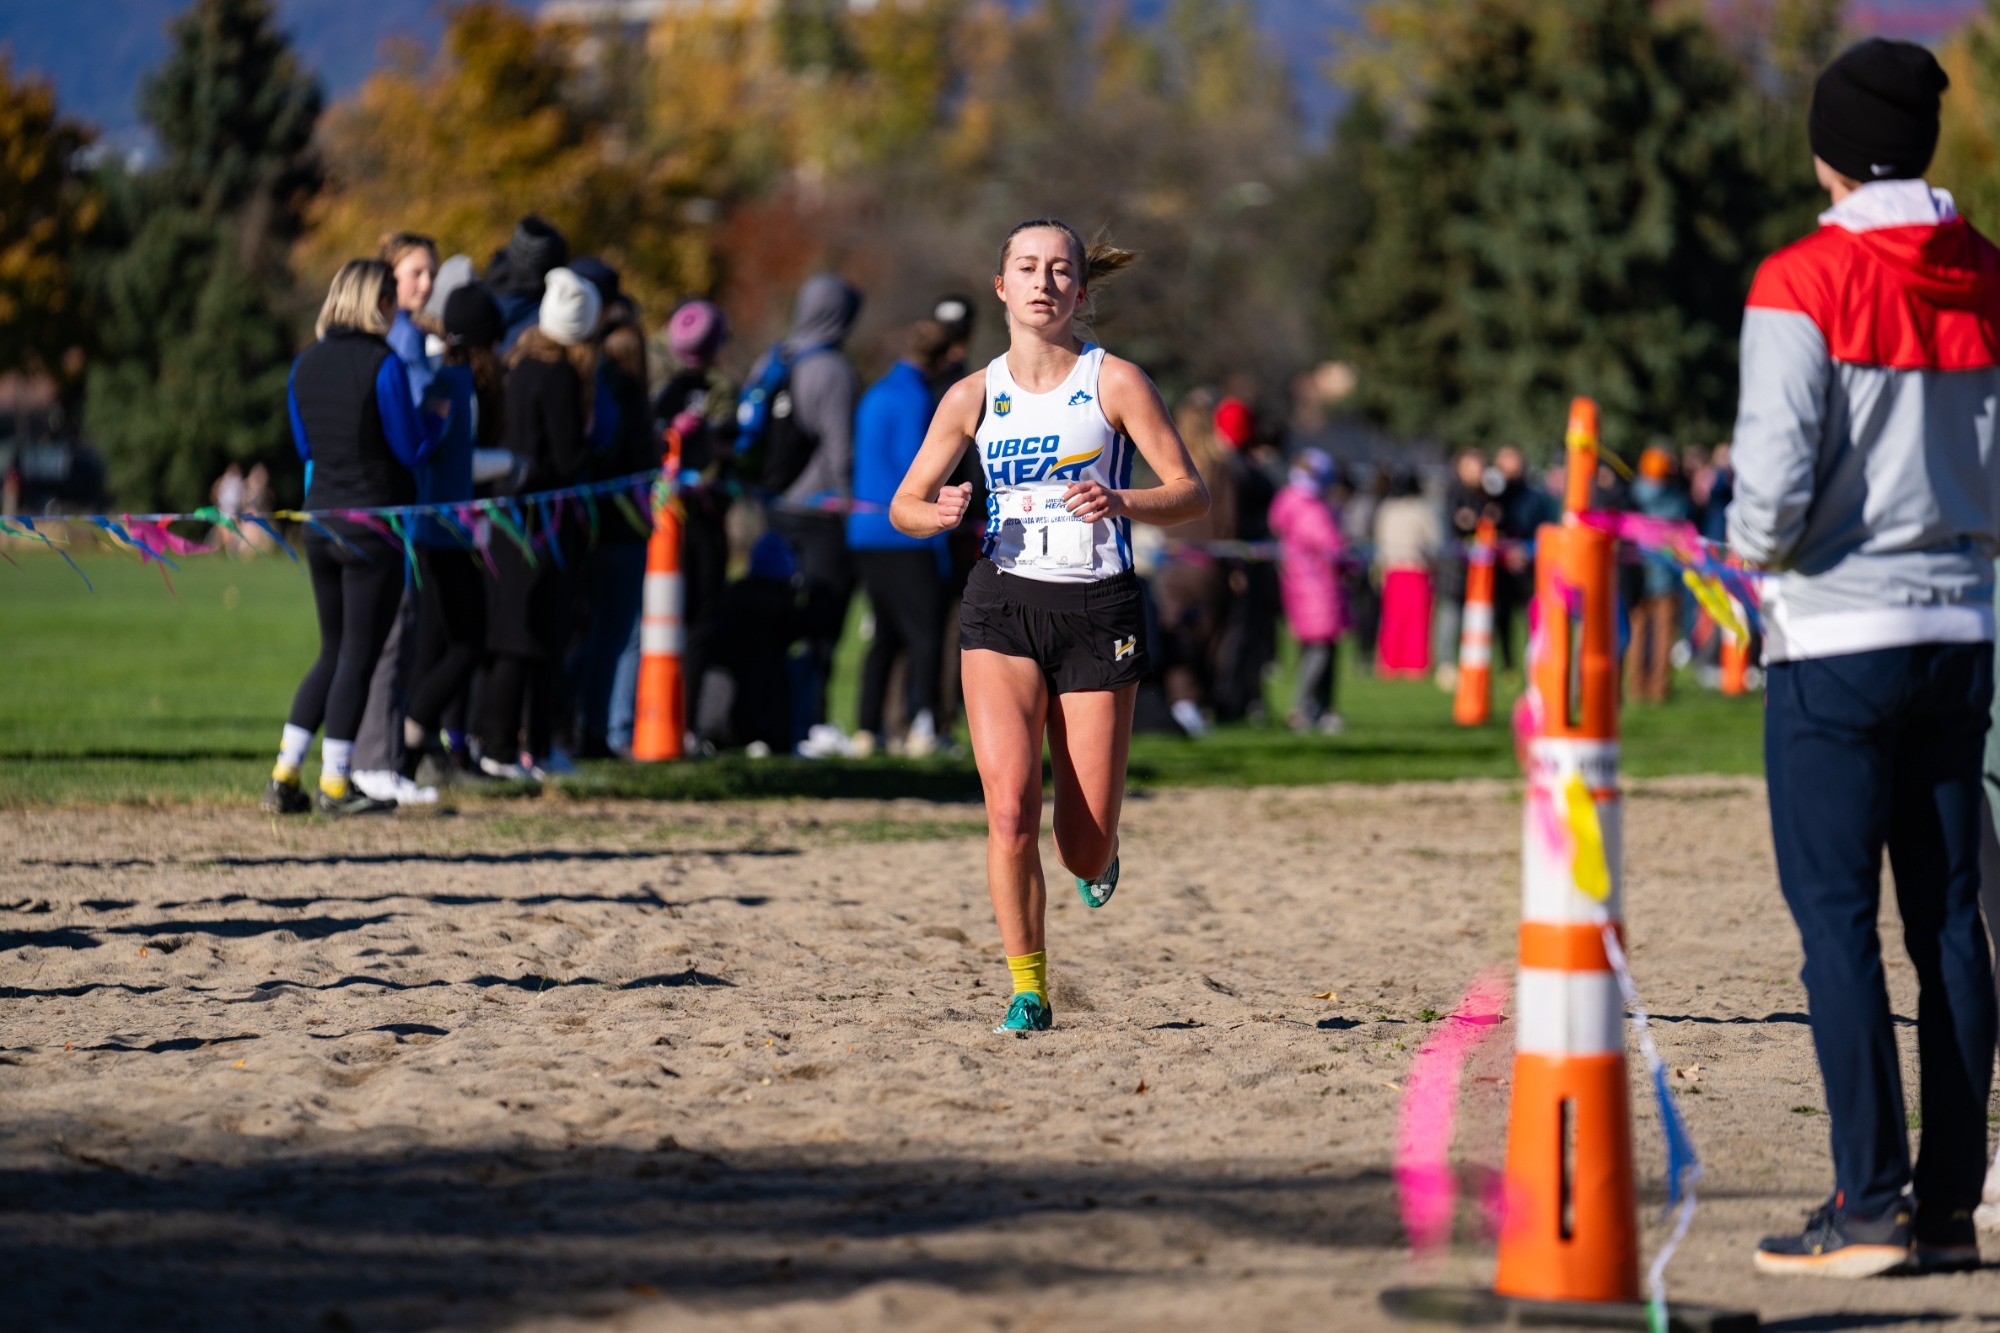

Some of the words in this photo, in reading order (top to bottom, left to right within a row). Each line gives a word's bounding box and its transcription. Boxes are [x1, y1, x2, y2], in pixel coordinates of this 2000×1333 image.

[995, 400, 1010, 413] CW
[987, 435, 1060, 460] UBCO
[987, 450, 1104, 489] HEAT
[1015, 517, 1035, 526] CANADA
[1035, 516, 1050, 524] WEST
[1038, 525, 1048, 556] 1
